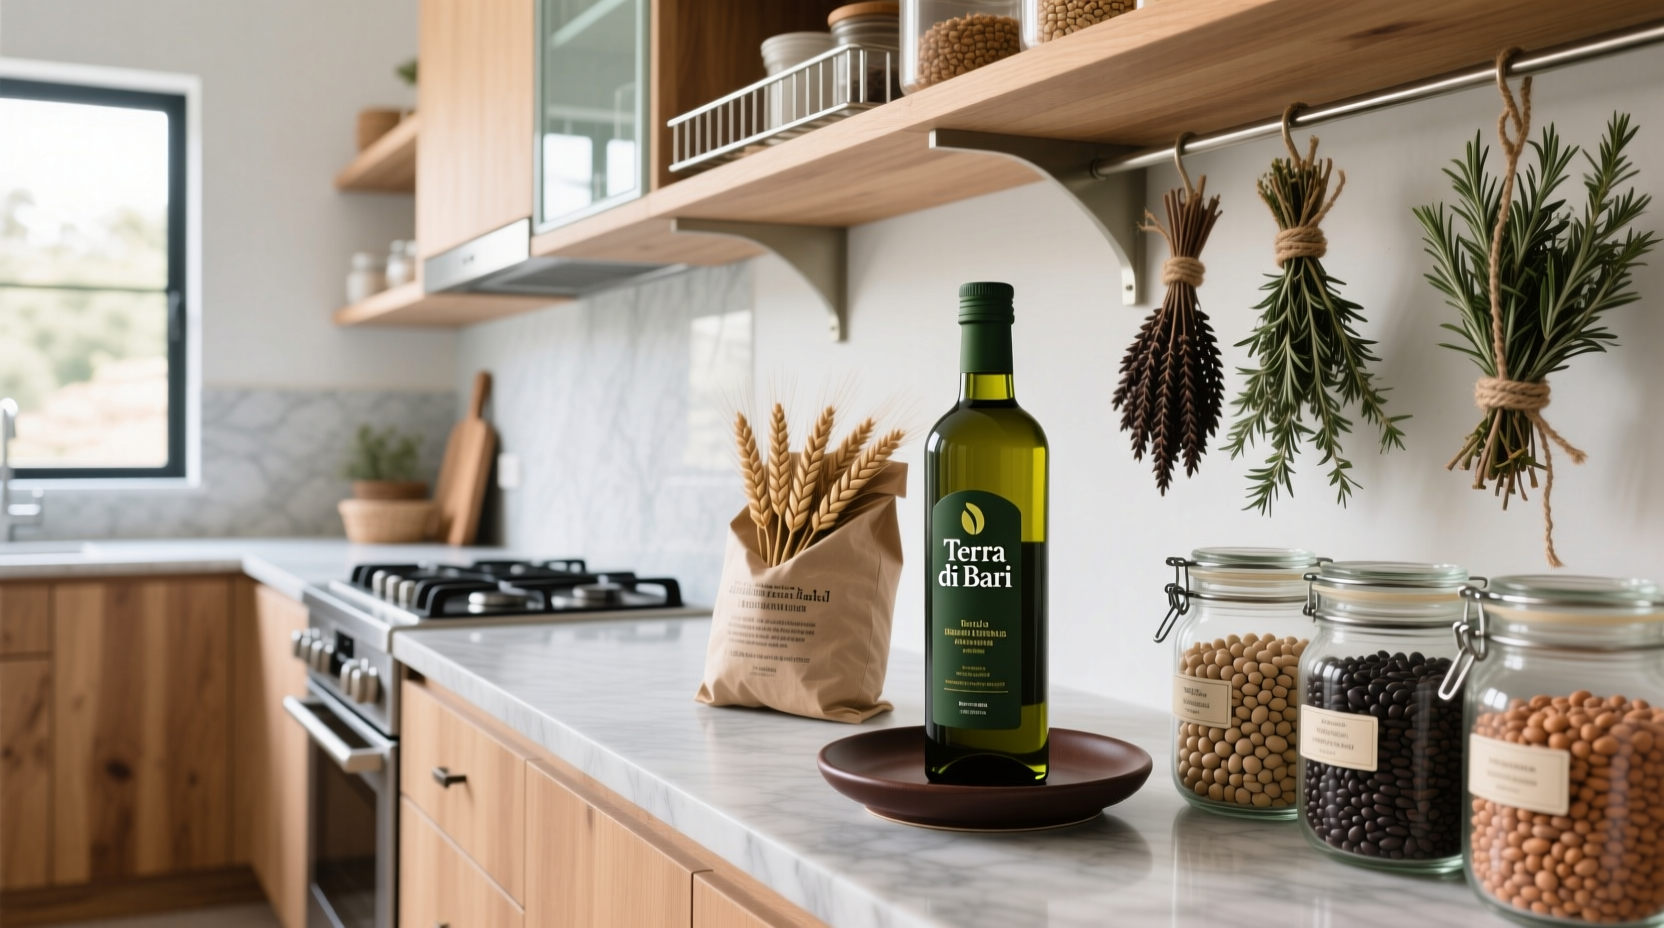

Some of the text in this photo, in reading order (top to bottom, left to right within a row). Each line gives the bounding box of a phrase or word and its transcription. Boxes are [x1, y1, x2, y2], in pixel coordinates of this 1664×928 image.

[943, 538, 1007, 562] Terra
[938, 563, 1013, 588] di Bari
